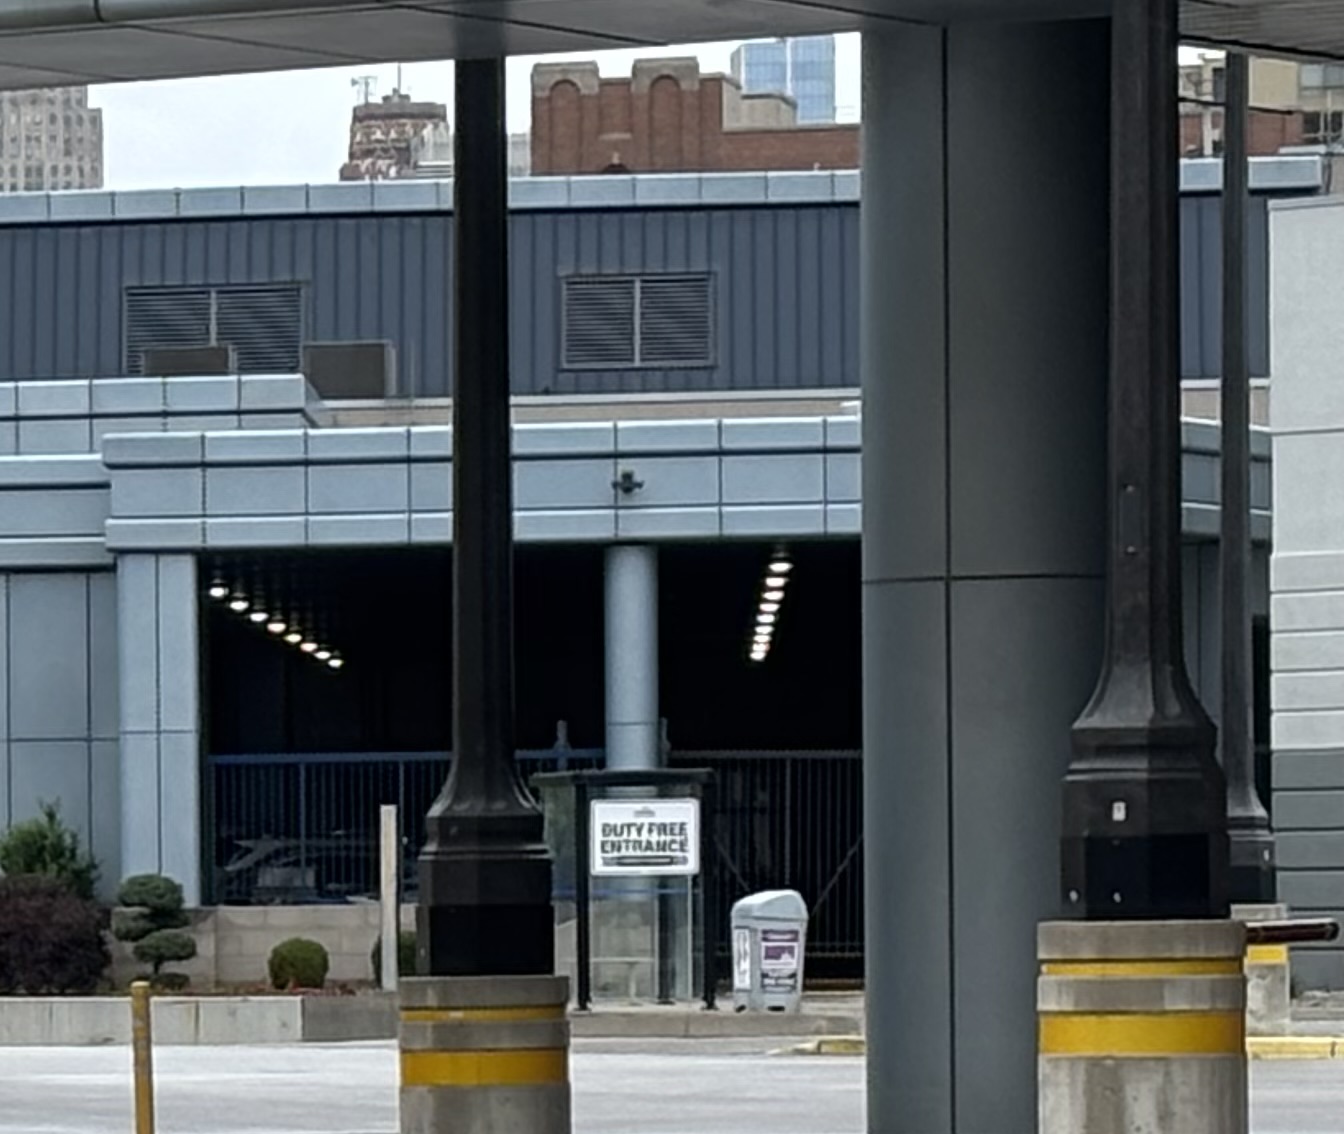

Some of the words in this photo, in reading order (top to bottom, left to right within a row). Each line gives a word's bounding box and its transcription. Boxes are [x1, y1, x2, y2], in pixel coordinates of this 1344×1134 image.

[602, 822, 645, 838] DUTY
[647, 822, 688, 837] FREE
[601, 839, 689, 854] ENTRANCE
